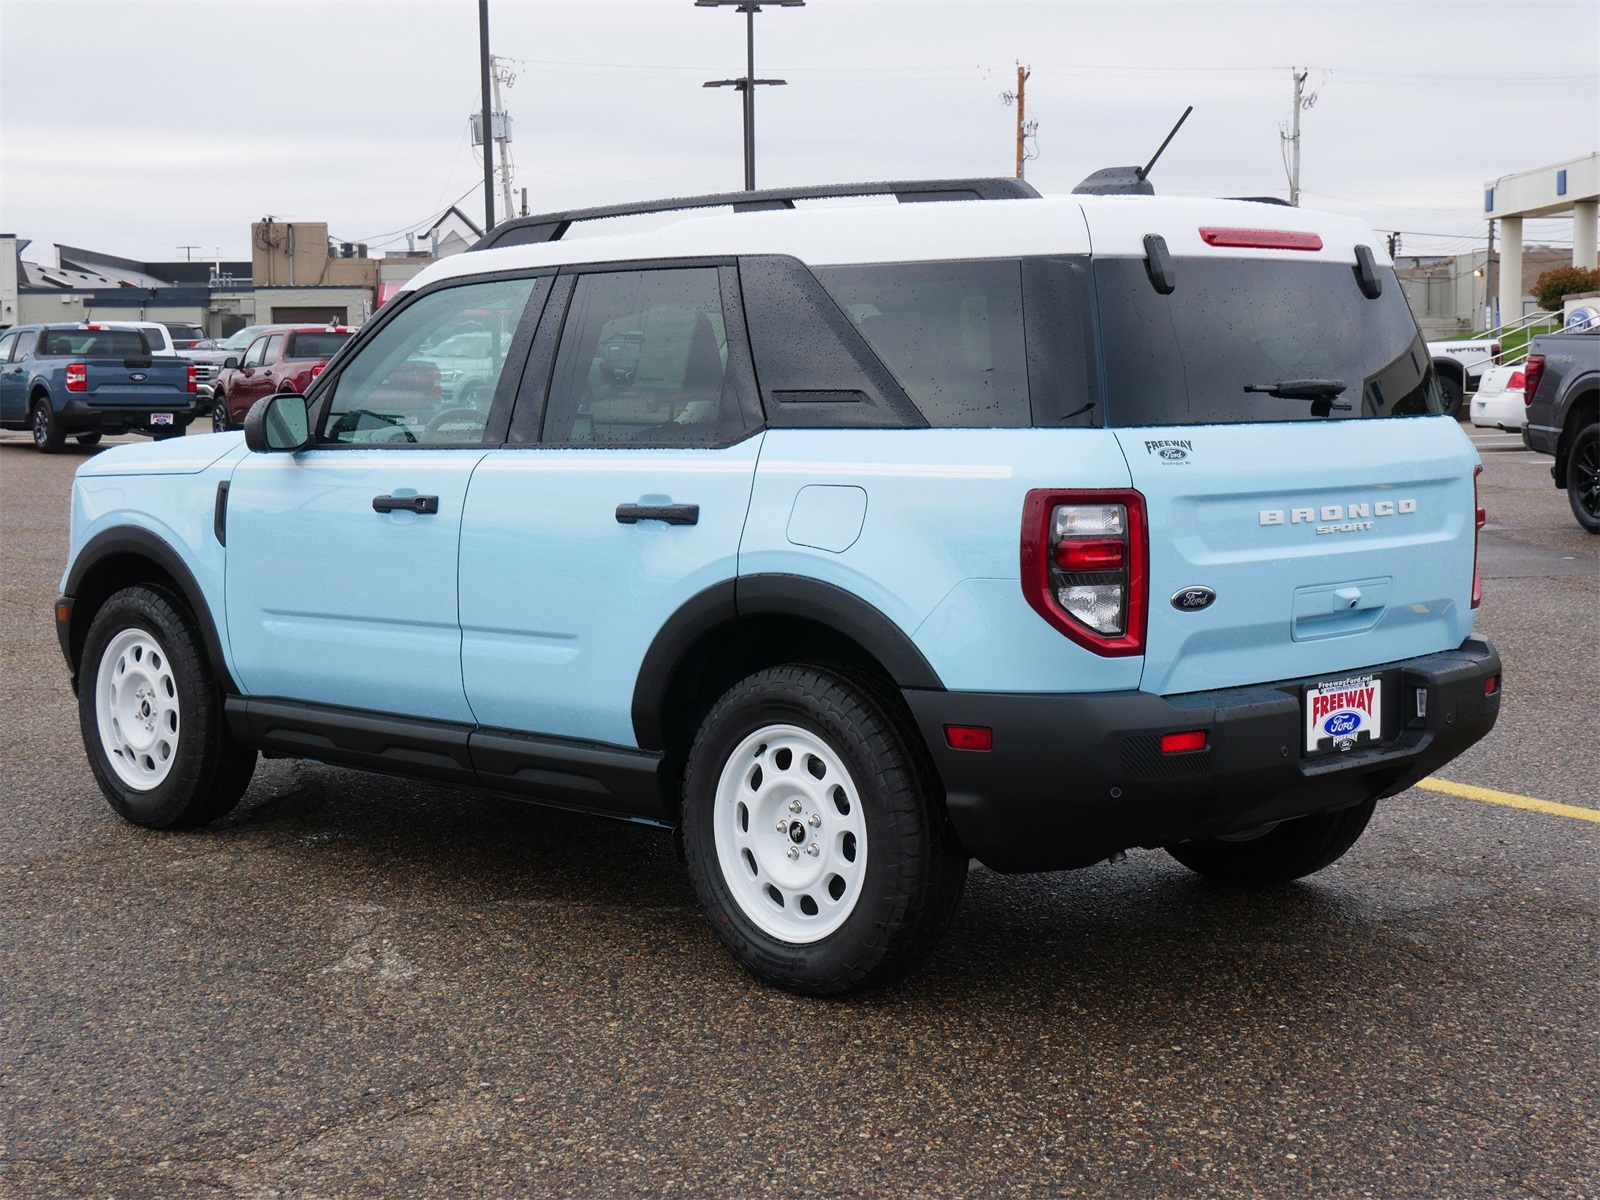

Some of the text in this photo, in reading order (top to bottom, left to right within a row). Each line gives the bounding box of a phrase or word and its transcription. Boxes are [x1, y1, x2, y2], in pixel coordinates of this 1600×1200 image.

[1144, 439, 1193, 454] FREEWAY
[1163, 449, 1182, 458] Ford
[1258, 499, 1417, 526] BRONCO
[1316, 521, 1374, 535] SPORT
[1182, 591, 1208, 607] Ford
[1318, 675, 1373, 689] FreewayFord.net
[1313, 687, 1375, 731] FREEWAY
[1330, 714, 1355, 733] Ford
